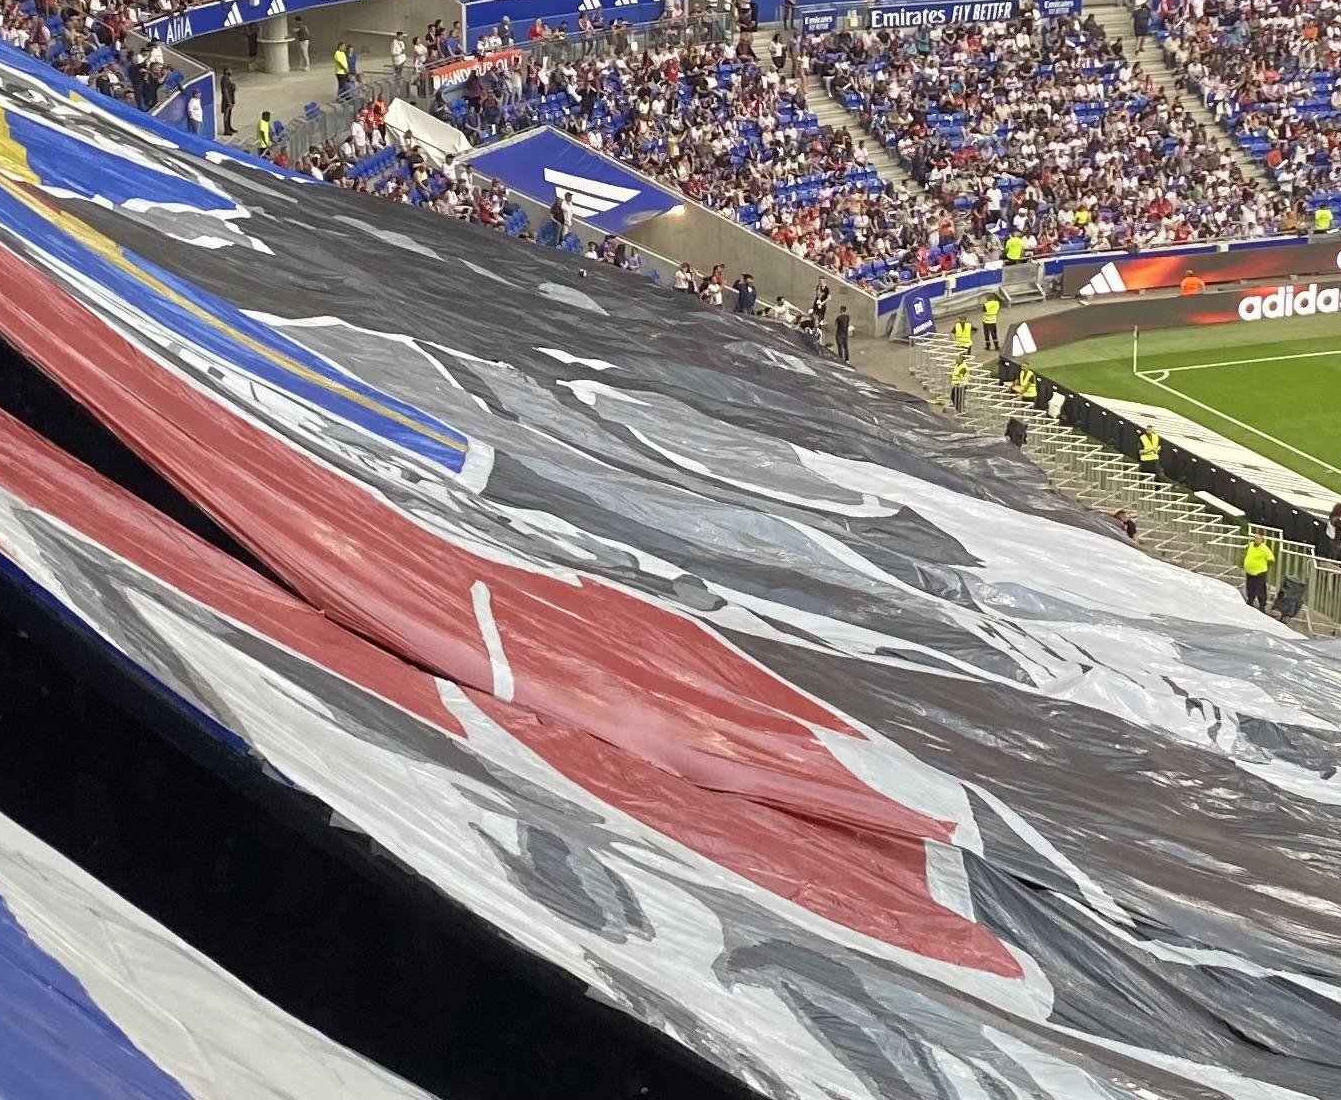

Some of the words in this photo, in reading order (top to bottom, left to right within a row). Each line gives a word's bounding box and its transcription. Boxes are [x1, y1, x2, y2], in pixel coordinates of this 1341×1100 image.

[871, 5, 947, 28] Emirates
[951, 3, 971, 23] FLY
[972, 0, 1013, 22] BETTER
